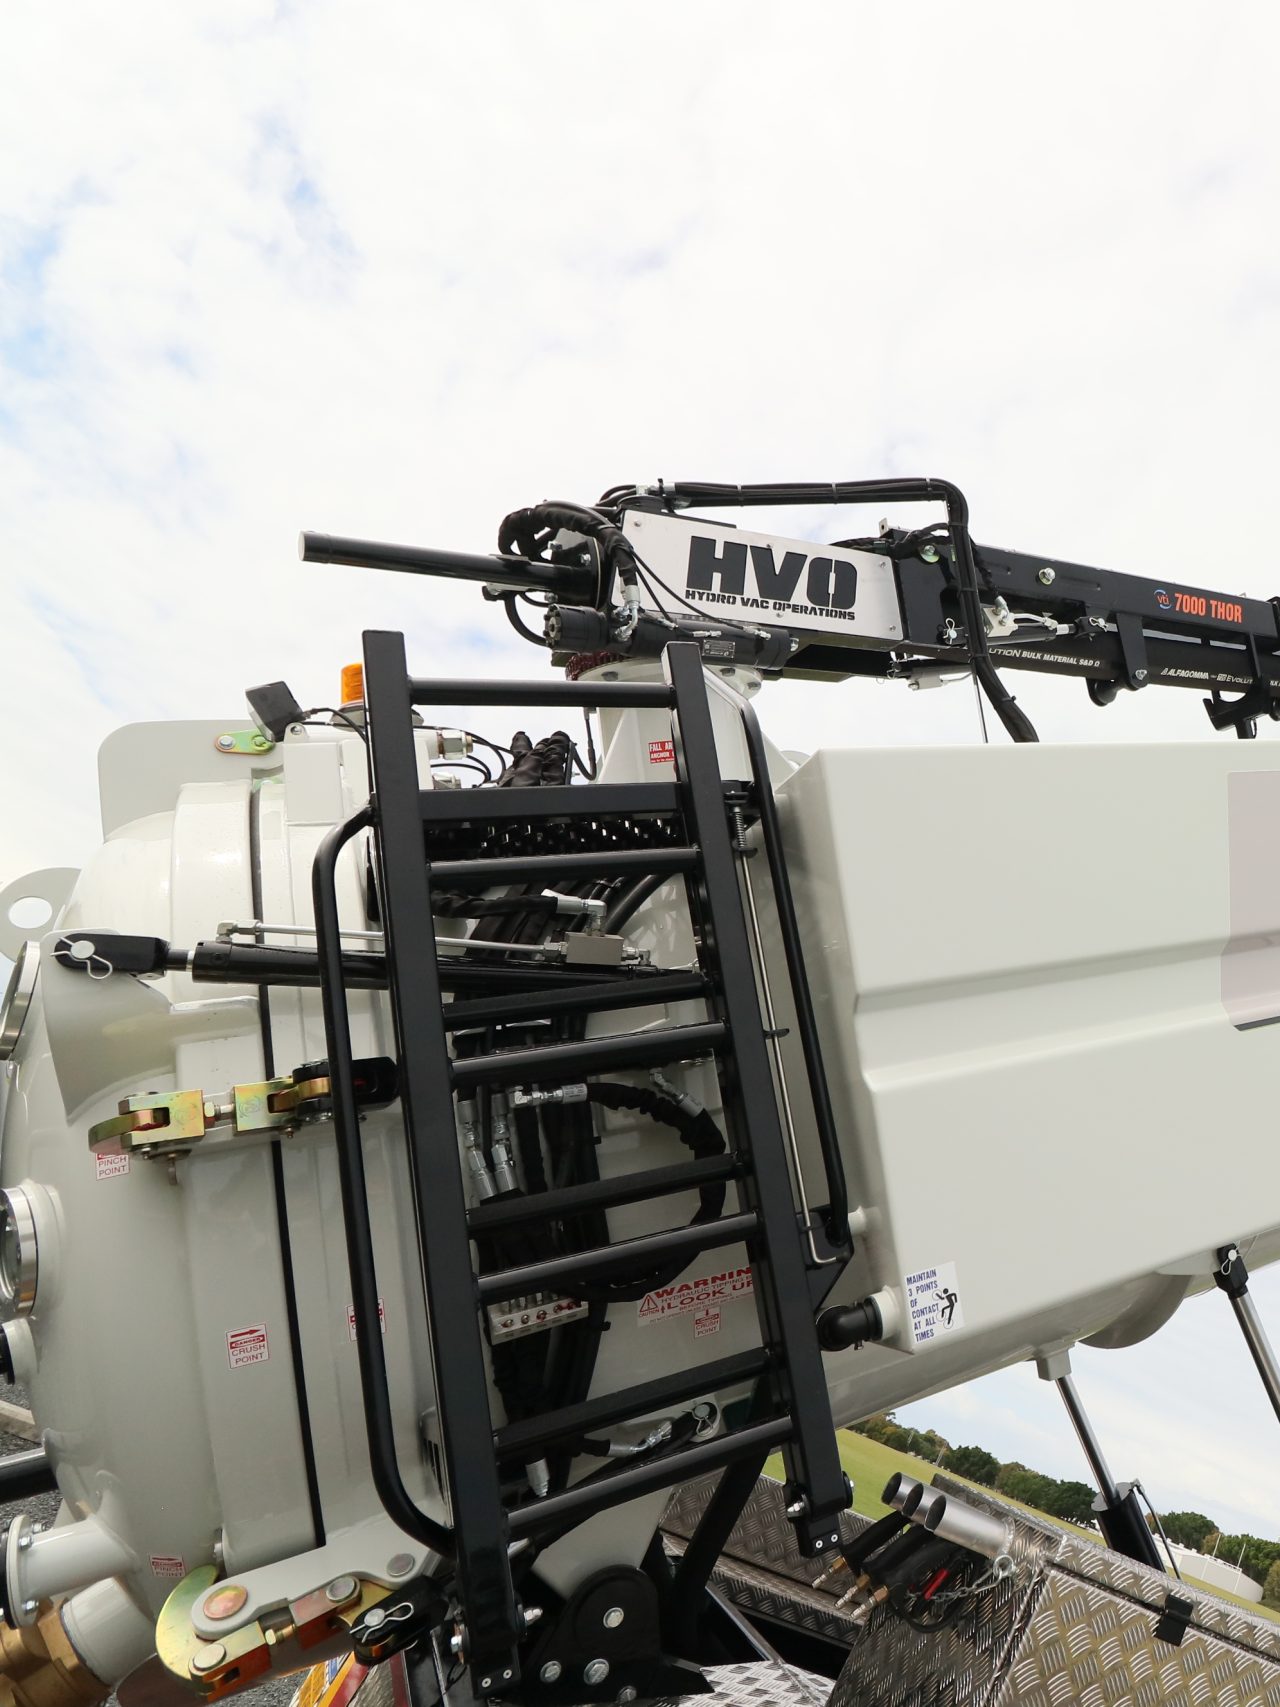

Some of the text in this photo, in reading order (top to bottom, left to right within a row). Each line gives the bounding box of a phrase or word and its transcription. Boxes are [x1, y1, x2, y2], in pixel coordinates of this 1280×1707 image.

[686, 536, 857, 609] HVO
[685, 590, 855, 620] HYDRO VAC OPERATIONS
[1174, 592, 1242, 623] 7000 THOR
[989, 648, 1021, 657] UTION
[1022, 651, 1041, 660] BULK
[1043, 654, 1077, 664] MATERIAL
[1167, 668, 1209, 680] ALFAGOMMA
[98, 1156, 127, 1168] PINCH
[98, 1165, 127, 1177] POINT
[654, 1266, 752, 1299] WARNIN
[906, 1269, 937, 1286] MAINTAIN
[661, 1284, 709, 1303] HYDRAULIC
[712, 1277, 744, 1290] TIPPING
[908, 1280, 938, 1297] 3 POINTS
[667, 1288, 724, 1310] LOOK
[910, 1298, 918, 1308] OF
[640, 1309, 659, 1318] CAUTION
[912, 1303, 939, 1319] CONTACT
[696, 1320, 719, 1330] CRUSH
[914, 1316, 936, 1331] AT ALL
[697, 1327, 717, 1336] POINT
[915, 1328, 935, 1342] TIMES
[231, 1343, 266, 1357] CRUSH
[235, 1352, 265, 1365] POINT
